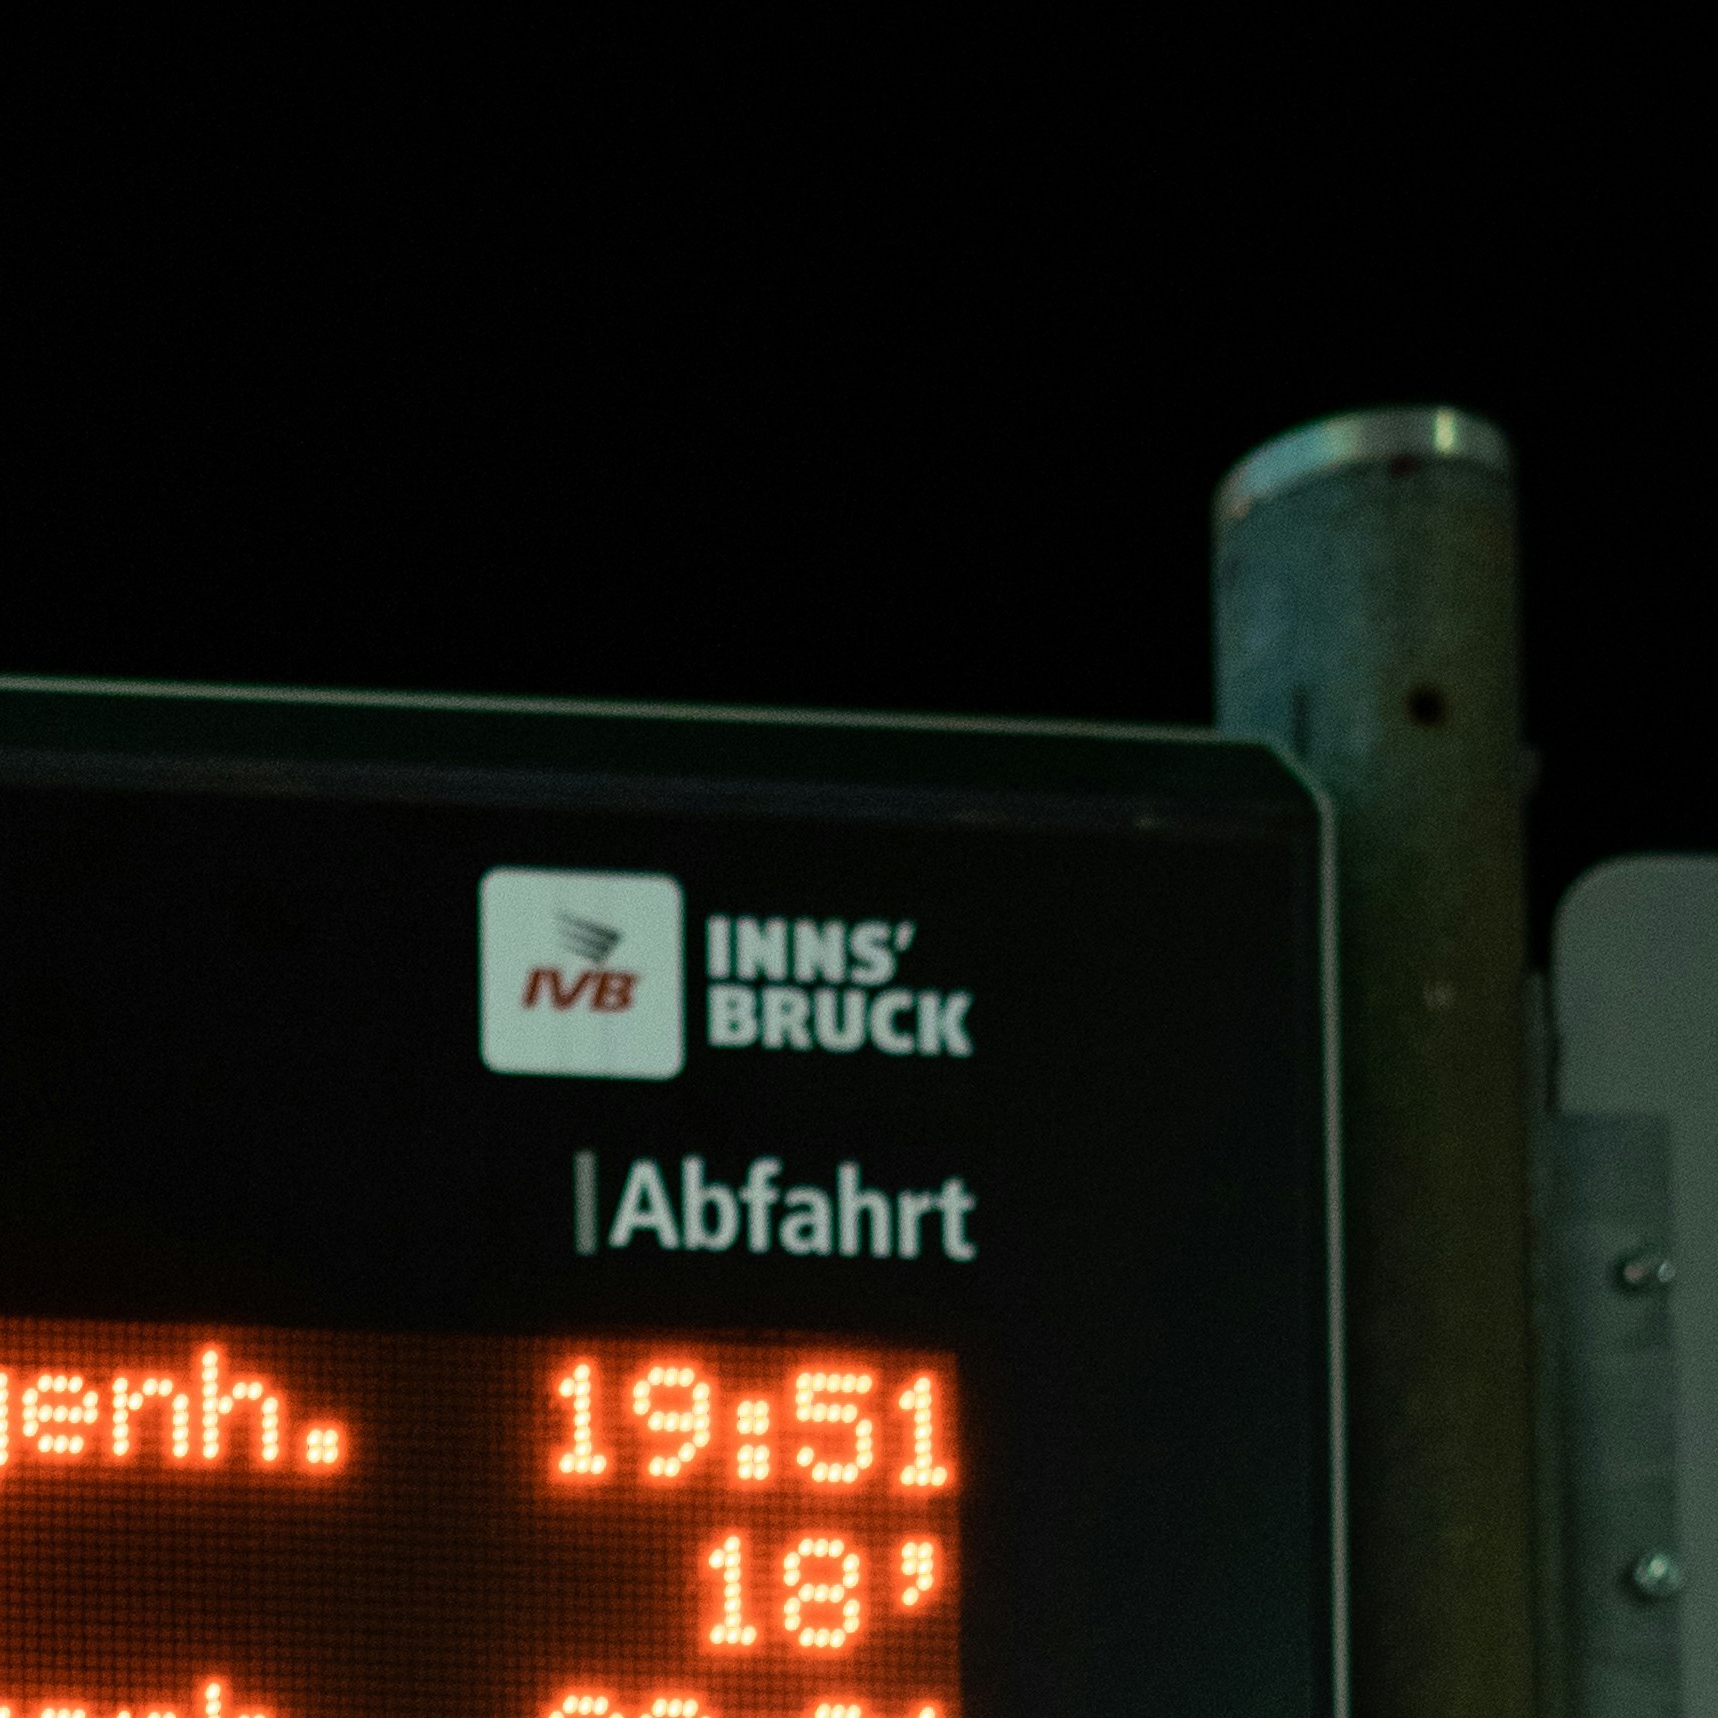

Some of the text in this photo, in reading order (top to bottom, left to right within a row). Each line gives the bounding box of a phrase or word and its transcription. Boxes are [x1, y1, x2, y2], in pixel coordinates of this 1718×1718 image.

[707, 914, 916, 985] INNS'
[521, 966, 642, 1013] IVB
[707, 985, 974, 1057] BRUCK
[608, 1155, 978, 1262] Abfahrt
[554, 1360, 952, 1490] 19:51
